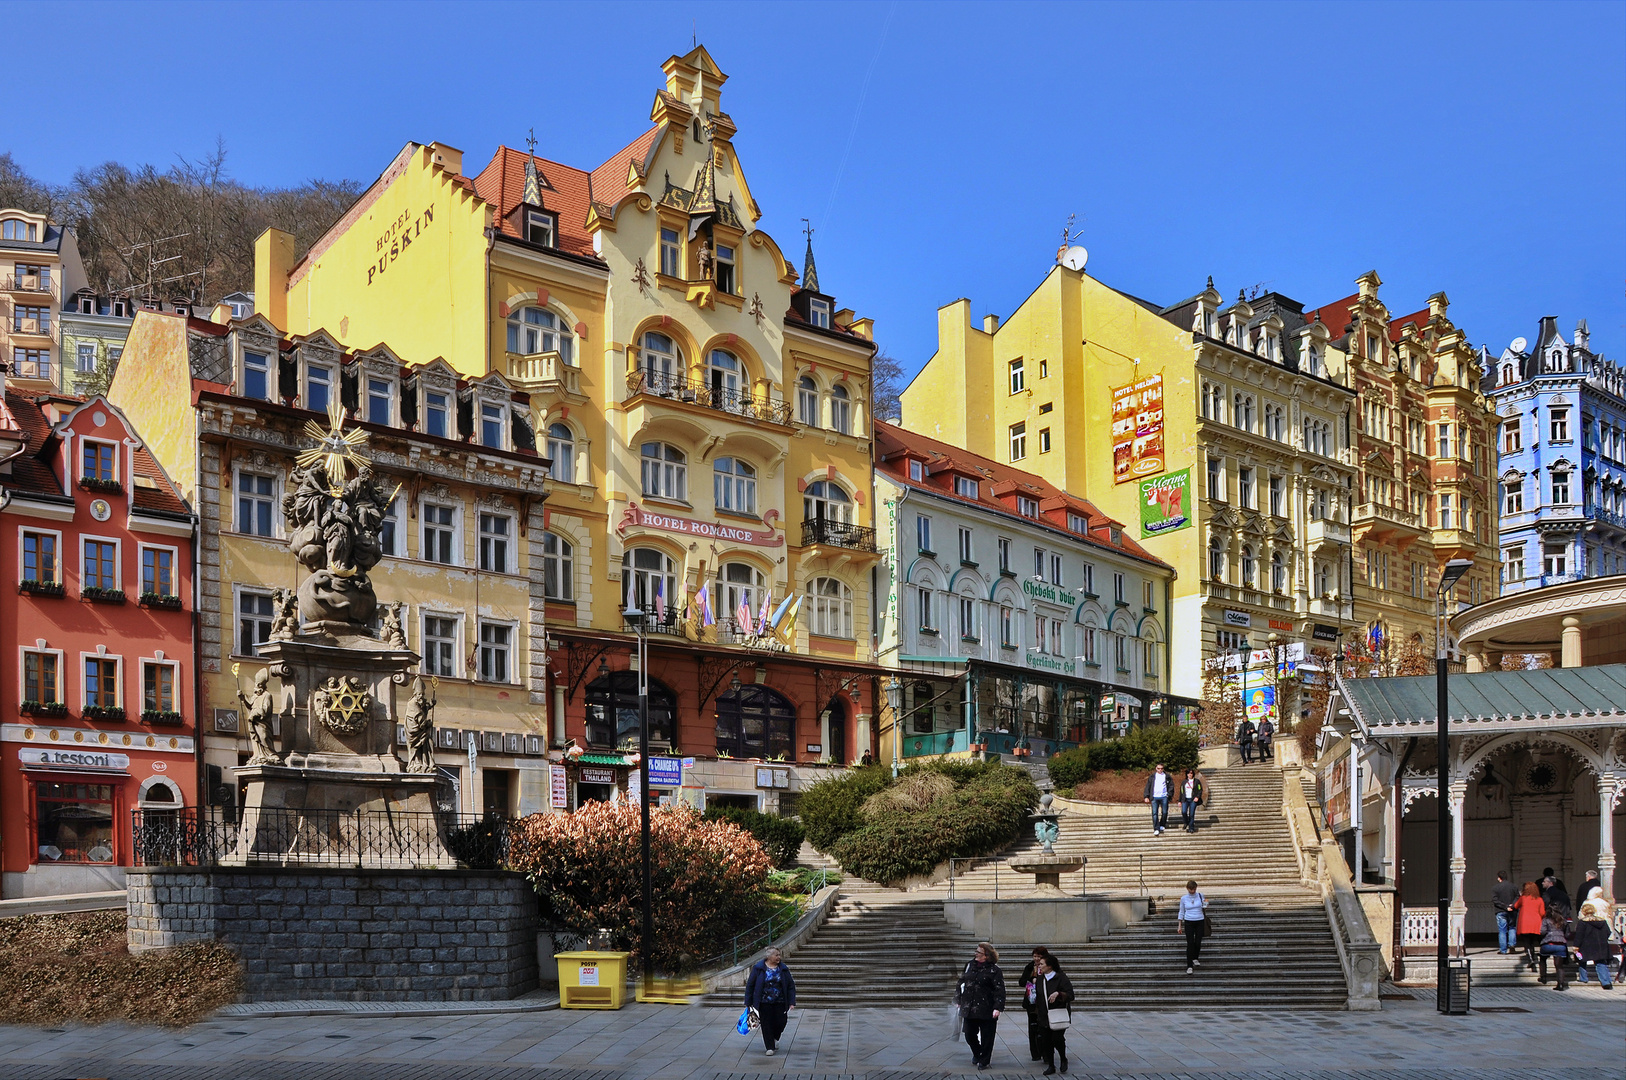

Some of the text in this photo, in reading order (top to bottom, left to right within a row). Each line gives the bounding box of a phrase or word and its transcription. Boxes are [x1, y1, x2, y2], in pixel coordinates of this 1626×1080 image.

[376, 208, 410, 252] HOTEL
[367, 203, 434, 286] PUŠKIN
[1114, 386, 1133, 398] HOTEL
[1142, 472, 1188, 492] Merino
[1143, 482, 1186, 497] AUSTRALIA
[643, 513, 753, 542] HOTEL ROMANCE
[40, 751, 109, 767] a.testoni
[655, 759, 672, 771] CHANGE
[583, 768, 613, 776] RESTAURANT
